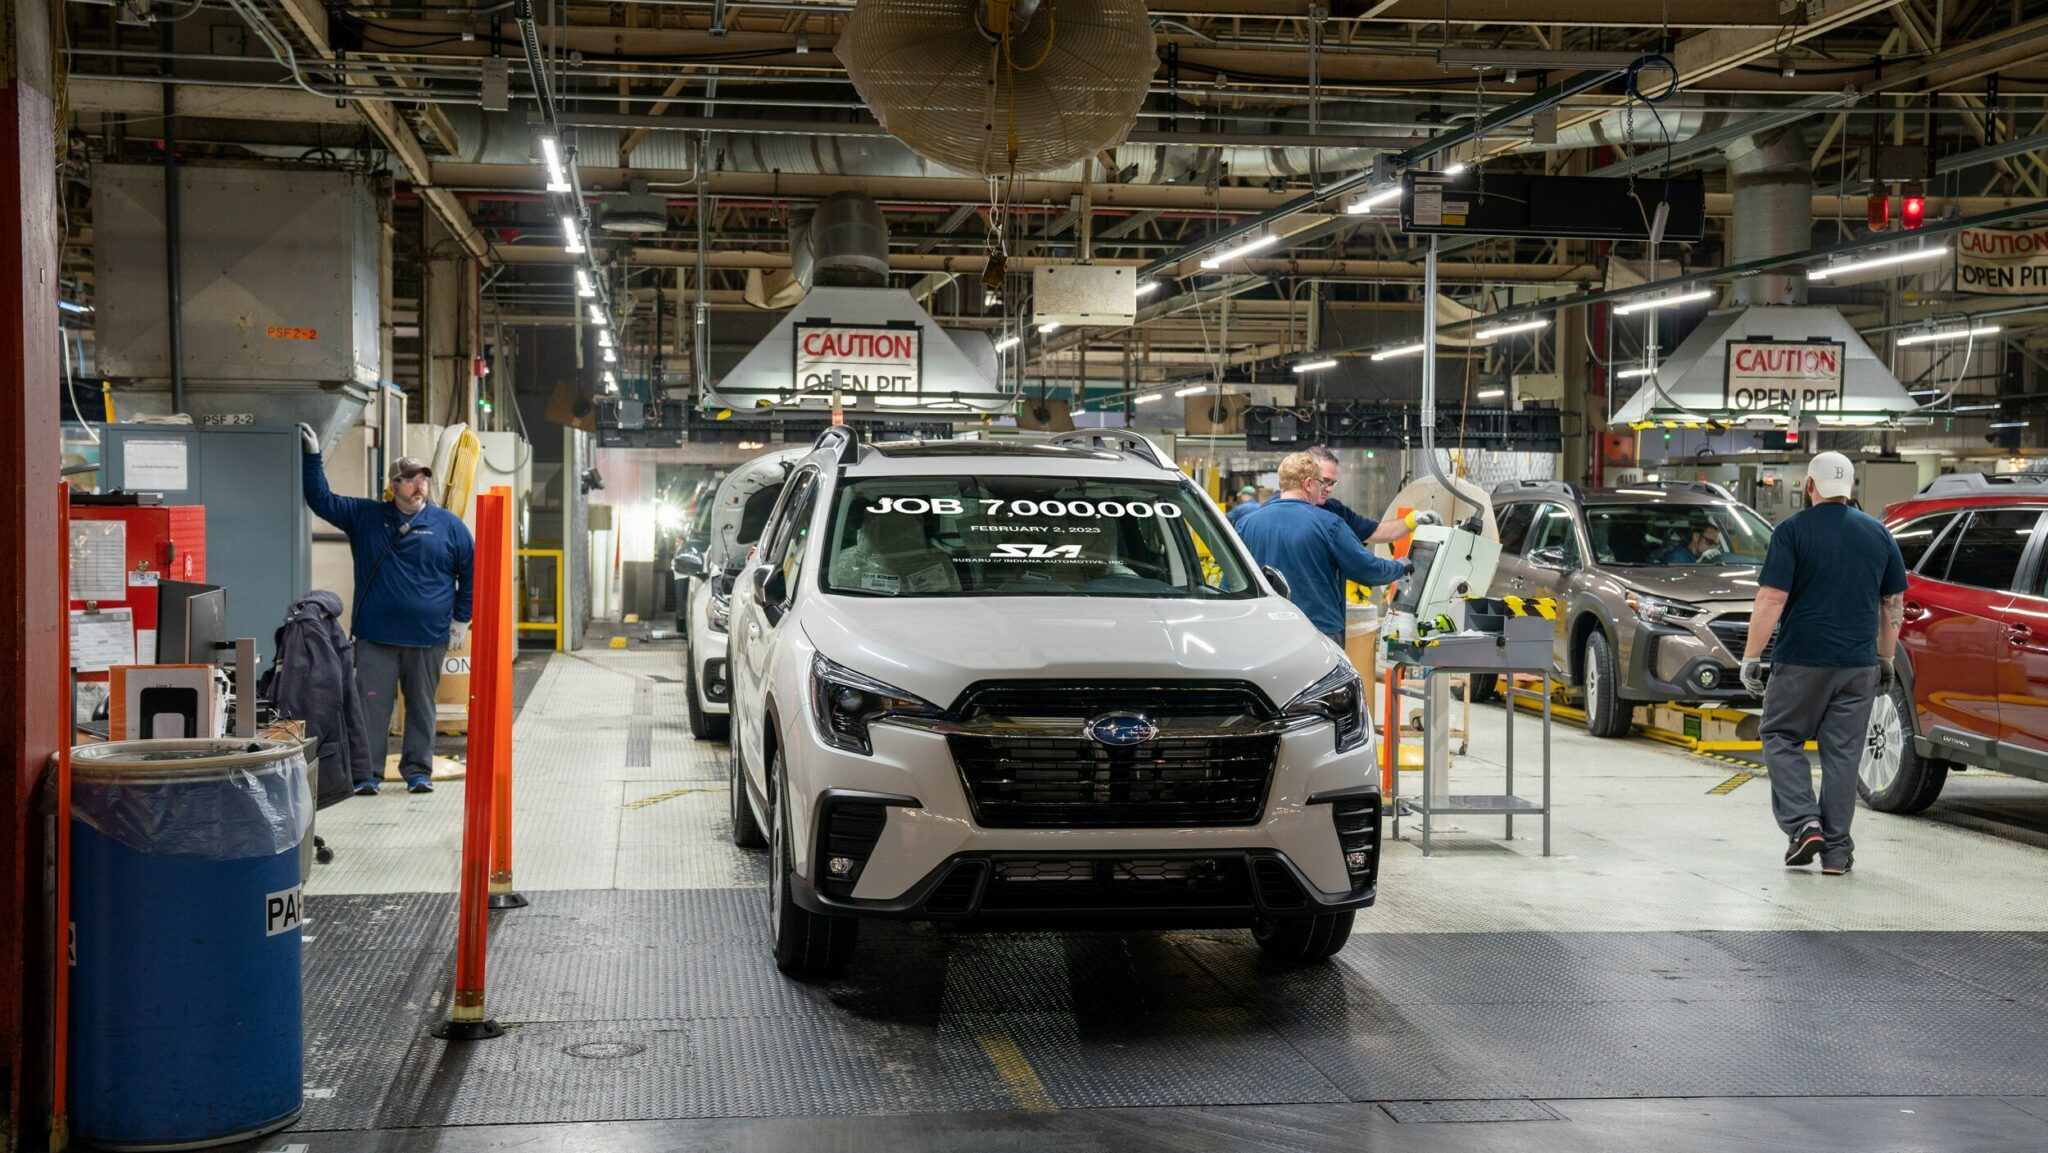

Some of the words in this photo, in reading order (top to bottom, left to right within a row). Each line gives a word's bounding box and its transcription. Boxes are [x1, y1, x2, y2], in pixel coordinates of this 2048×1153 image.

[1960, 230, 2048, 254] CAUTION
[1963, 265, 2014, 287] OPEN
[2020, 266, 2048, 287] PIT
[803, 333, 912, 358] CAUTION
[1735, 349, 1836, 373] CAUTION
[877, 375, 912, 391] PIT
[1803, 388, 1837, 410] PIT
[203, 415, 227, 424] PSF
[233, 415, 253, 424] 2-2
[866, 497, 964, 515] JOB
[979, 499, 1181, 519] 7,000,000
[970, 525, 1049, 533] FEBRUARY
[1052, 526, 1065, 534] 2,
[1068, 526, 1101, 534] 2023
